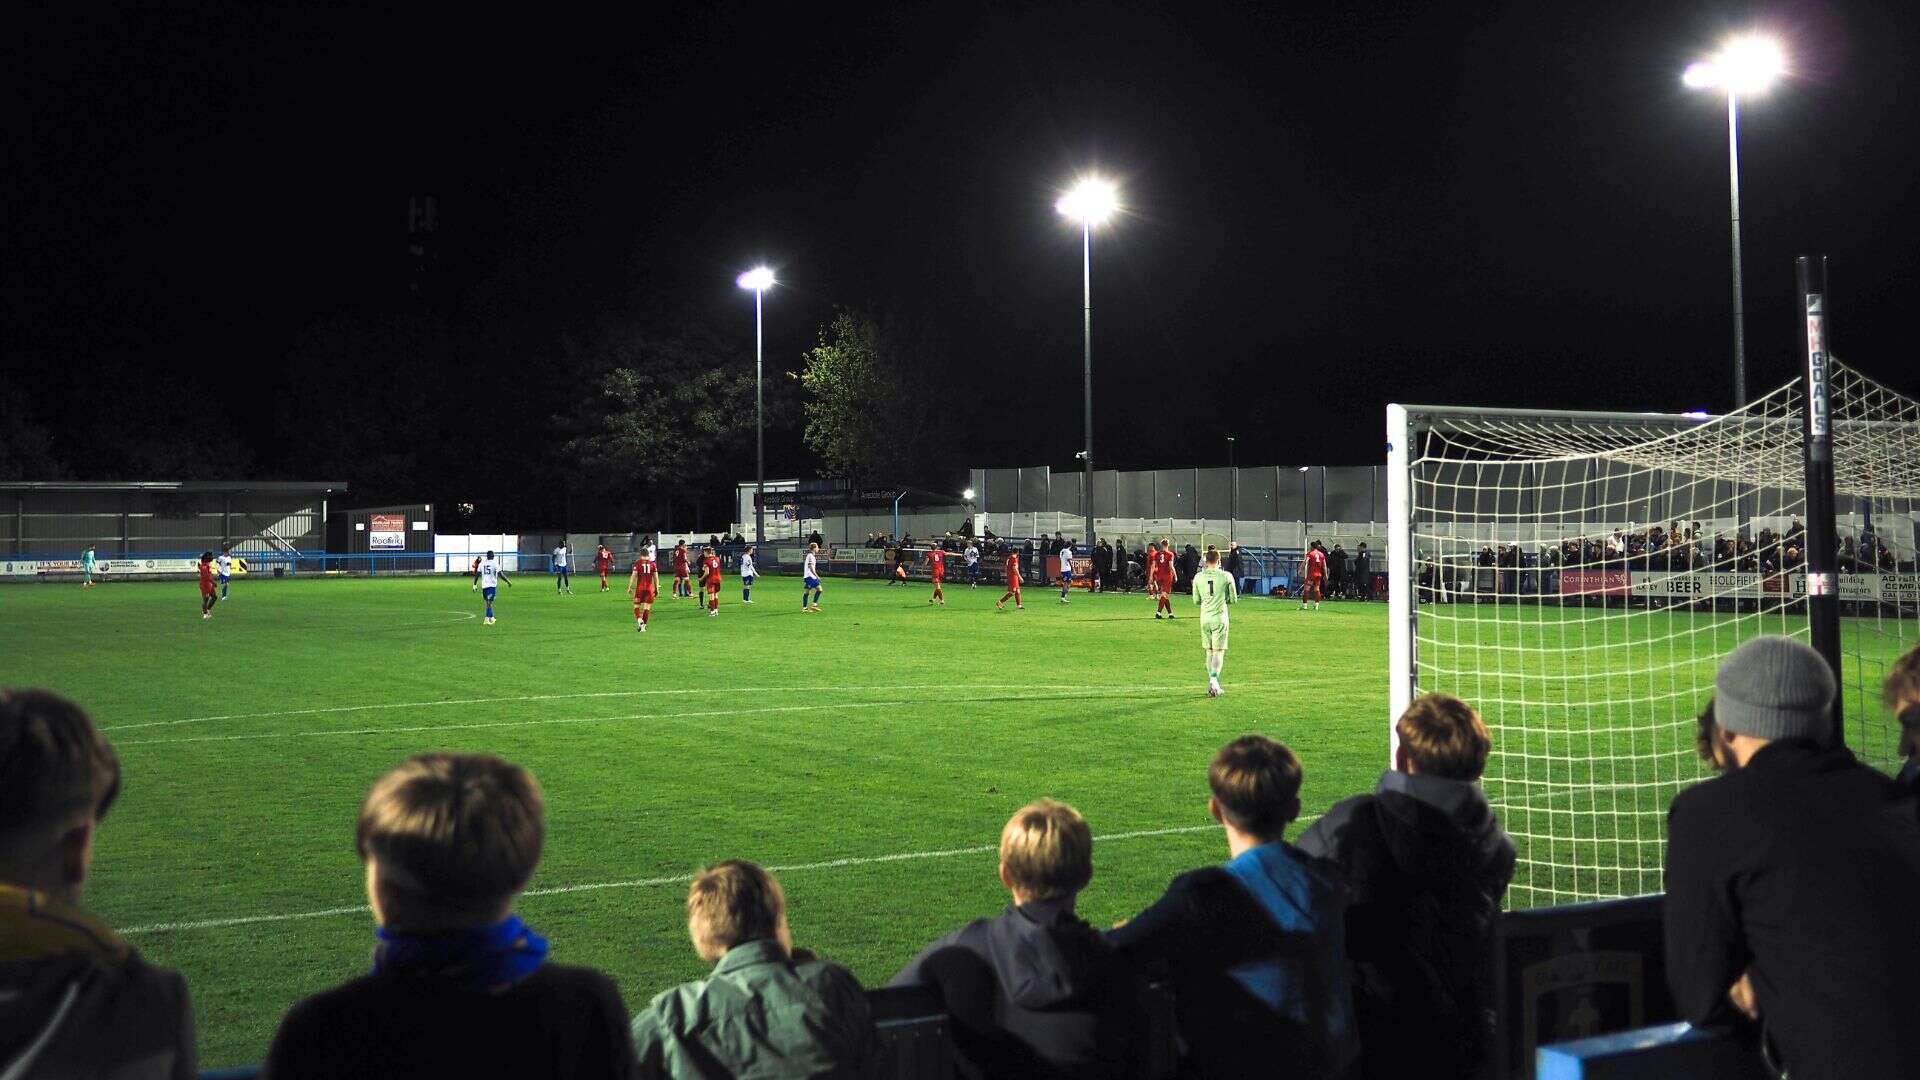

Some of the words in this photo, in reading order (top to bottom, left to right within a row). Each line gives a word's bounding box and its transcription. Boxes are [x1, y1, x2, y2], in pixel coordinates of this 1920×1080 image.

[483, 565, 491, 575] 15
[642, 563, 651, 574] 11
[1563, 575, 1615, 583] CORNTHIAN
[1839, 576, 1865, 586] uilding
[1207, 580, 1214, 596] 1
[1666, 581, 1701, 594] BEER
